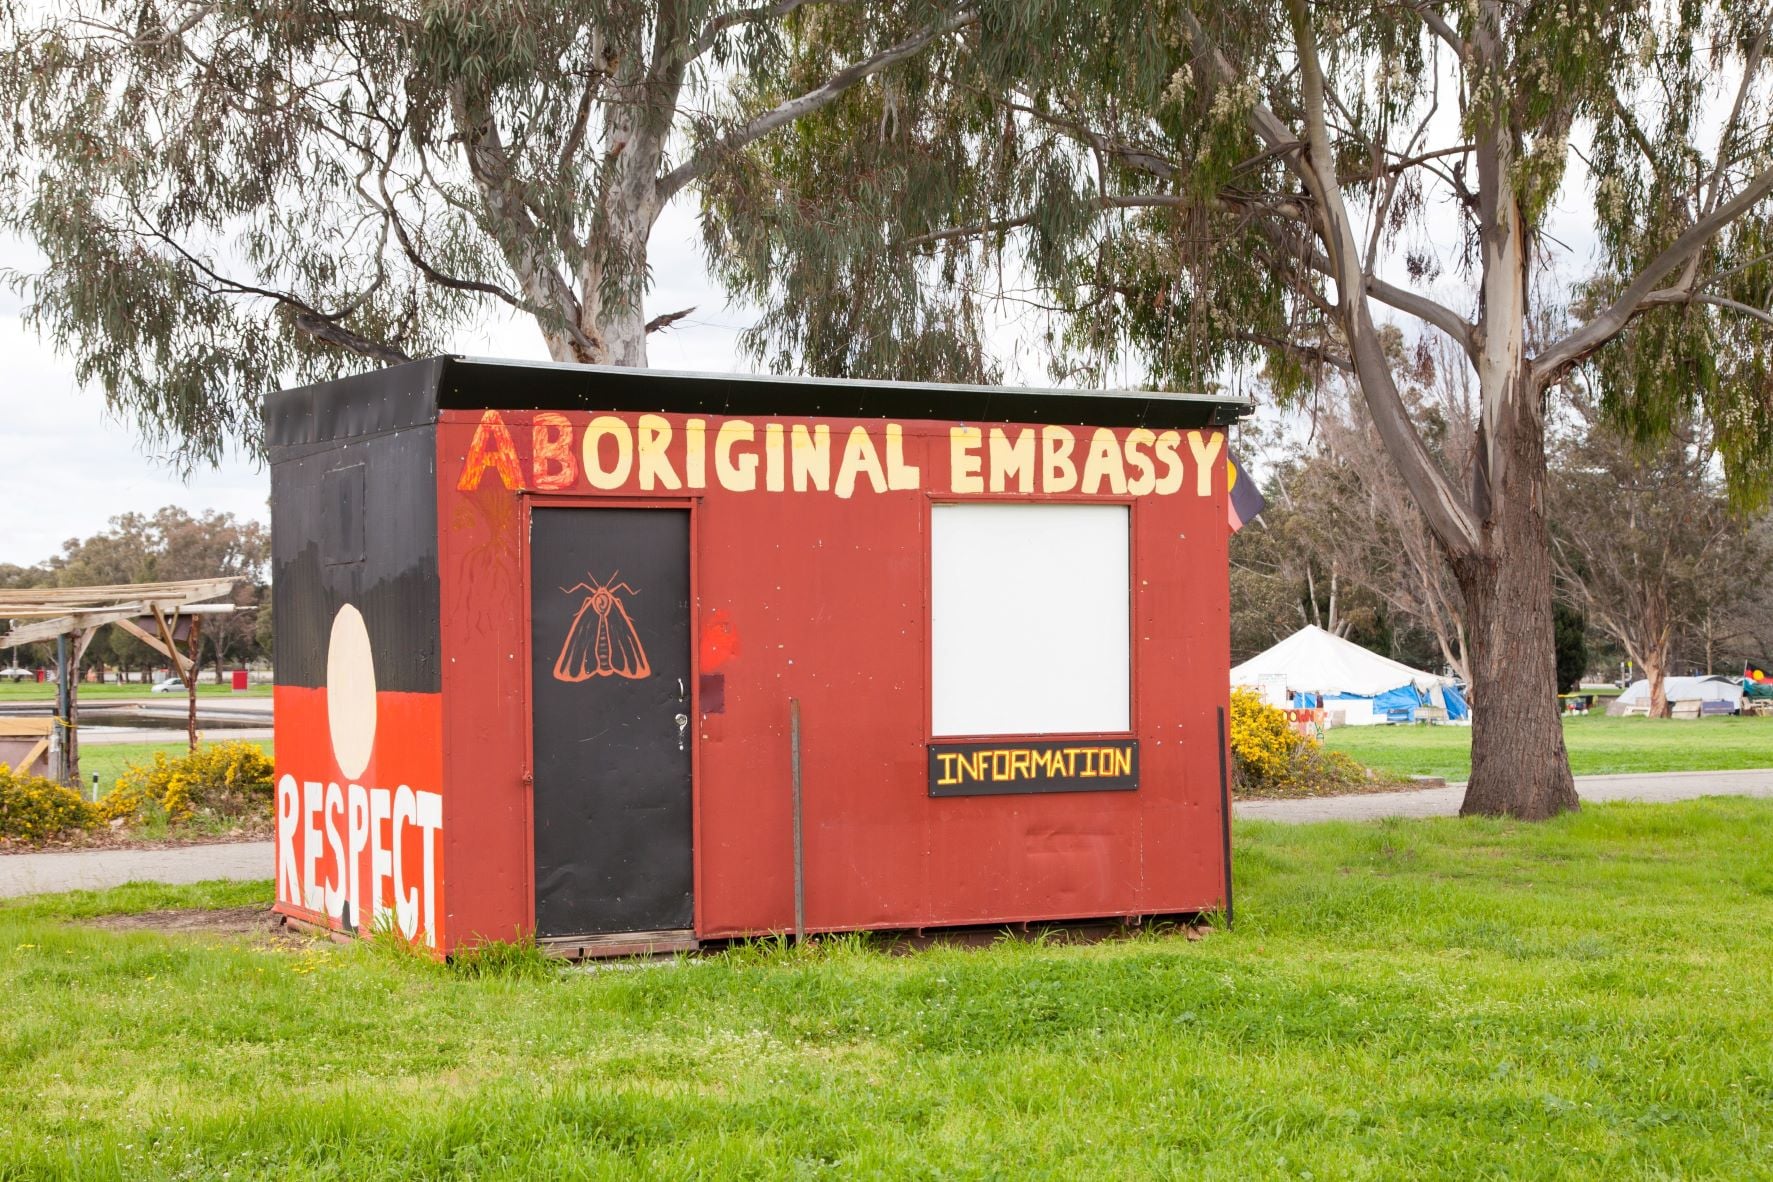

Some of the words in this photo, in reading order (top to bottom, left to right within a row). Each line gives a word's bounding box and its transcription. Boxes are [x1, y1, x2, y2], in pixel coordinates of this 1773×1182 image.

[456, 409, 920, 499] ABORIGINAL
[950, 425, 1224, 496] EMBASSY
[936, 747, 1132, 785] INFORMATION
[278, 773, 443, 948] RESPECT
